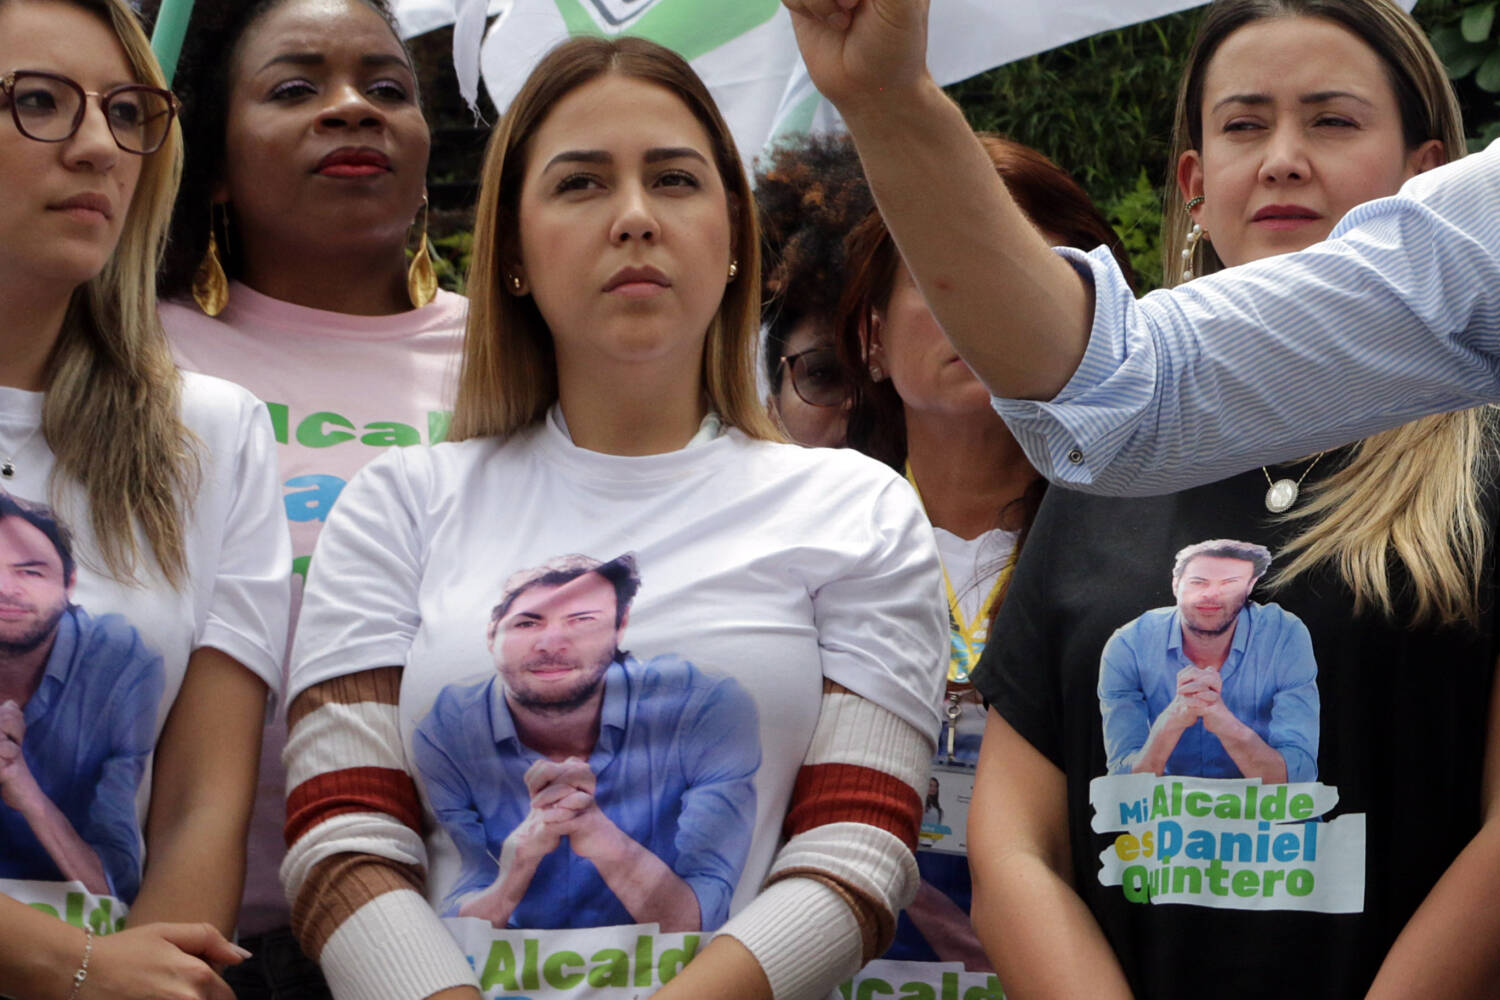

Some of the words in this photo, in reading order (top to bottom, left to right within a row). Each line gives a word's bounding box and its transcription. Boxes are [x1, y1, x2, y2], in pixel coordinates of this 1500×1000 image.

[1119, 798, 1149, 825] Mi
[1150, 782, 1314, 821] Alcalde
[1114, 831, 1154, 861] es
[1157, 821, 1317, 862] Daniel
[1122, 856, 1315, 904] Quintero
